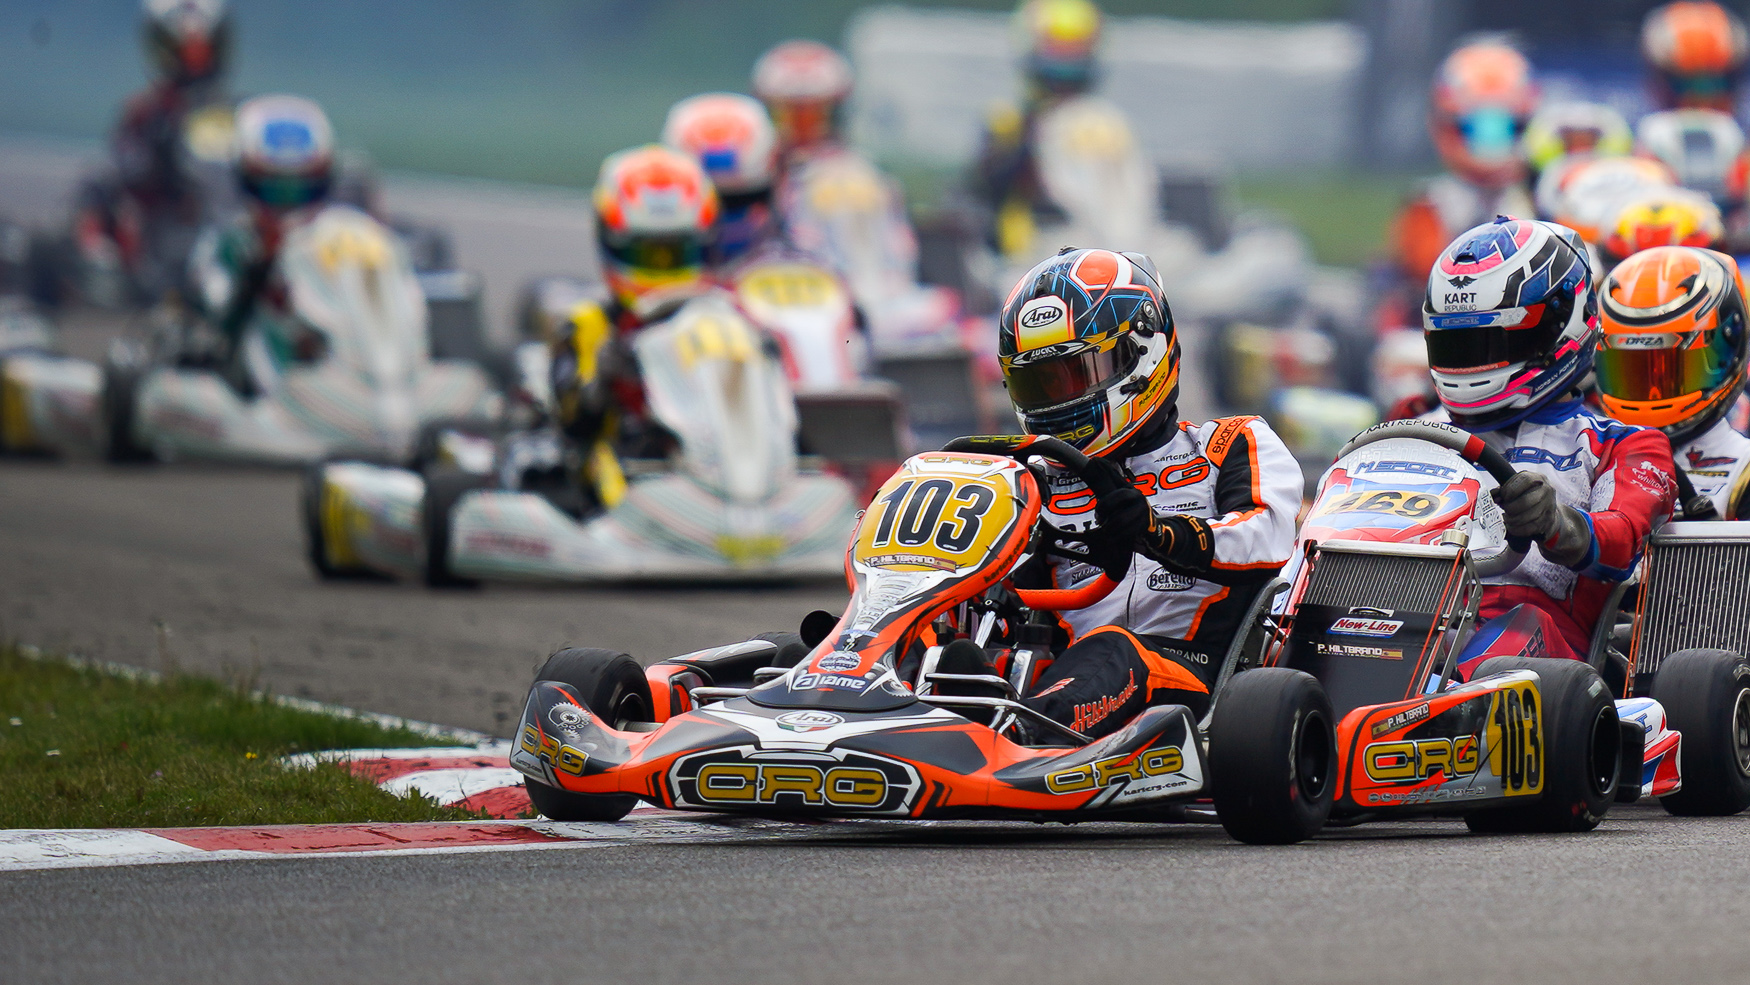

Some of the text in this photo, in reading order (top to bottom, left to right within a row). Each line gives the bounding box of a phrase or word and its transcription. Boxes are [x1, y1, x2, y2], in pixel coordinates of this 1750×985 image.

[1444, 292, 1477, 304] KART
[1028, 306, 1058, 323] Arai
[1444, 304, 1477, 312] REPUBLIC
[1032, 346, 1058, 357] LUCKY
[1057, 424, 1095, 441] RG
[1212, 417, 1246, 454] sparco
[872, 478, 997, 554] 103
[1335, 618, 1398, 631] New-Line
[1328, 644, 1383, 656] HILTBRAND
[819, 675, 866, 689] iame
[1495, 688, 1542, 791] 103
[520, 723, 590, 777] CRG
[1363, 734, 1480, 784] CRG
[1044, 745, 1185, 795] CRG
[696, 762, 889, 806] CRG
[1124, 779, 1188, 796] kartcrg.com
